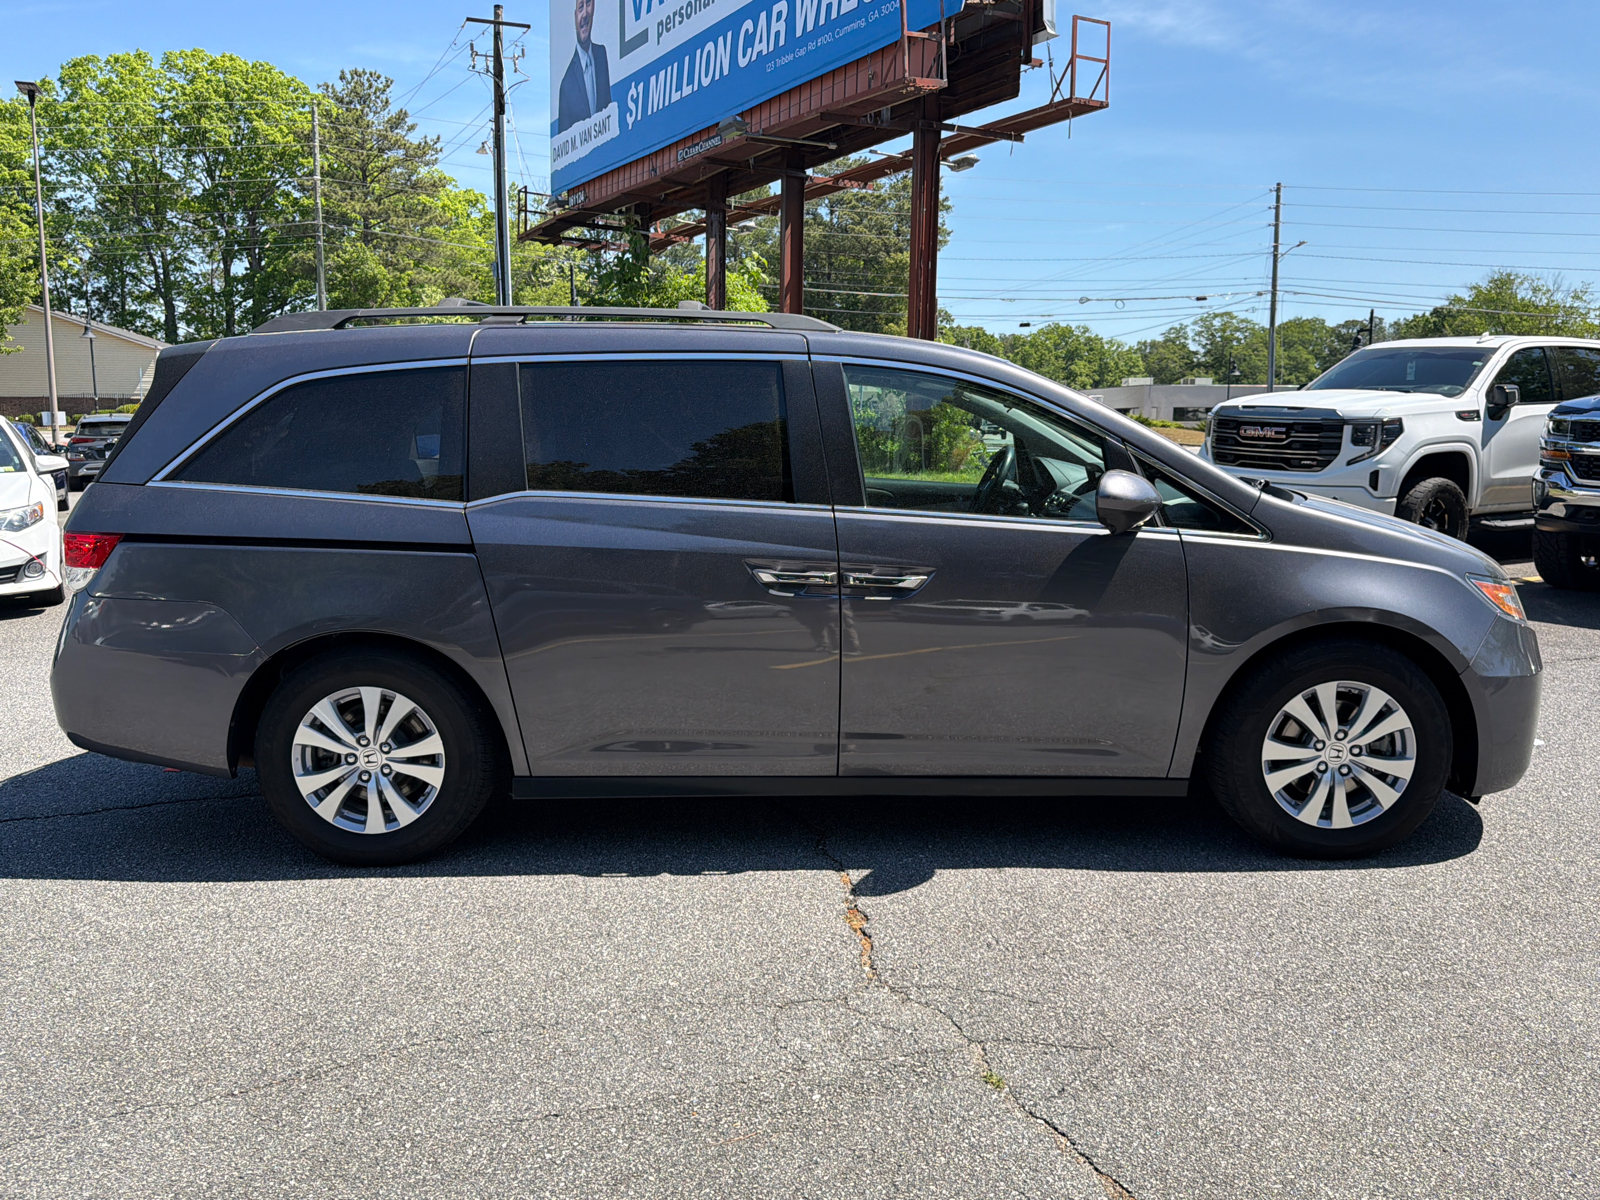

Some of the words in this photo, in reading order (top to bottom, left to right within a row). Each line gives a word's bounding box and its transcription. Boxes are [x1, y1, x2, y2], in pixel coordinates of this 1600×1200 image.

[626, 81, 644, 131] $1
[647, 30, 732, 116] MILLION
[737, 0, 789, 68] CAR
[765, 60, 775, 73] 123
[776, 52, 795, 68] Tribble
[794, 46, 807, 58] Gap
[807, 40, 817, 52] Rd
[817, 32, 834, 47] #100,
[834, 18, 867, 39] Cumming,
[868, 9, 879, 22] GA
[881, 0, 900, 16] 3004
[552, 140, 570, 163] DAVID
[570, 135, 578, 153] M.
[579, 125, 593, 147] VAN
[593, 114, 612, 139] SANT
[1239, 425, 1287, 439] GMC
